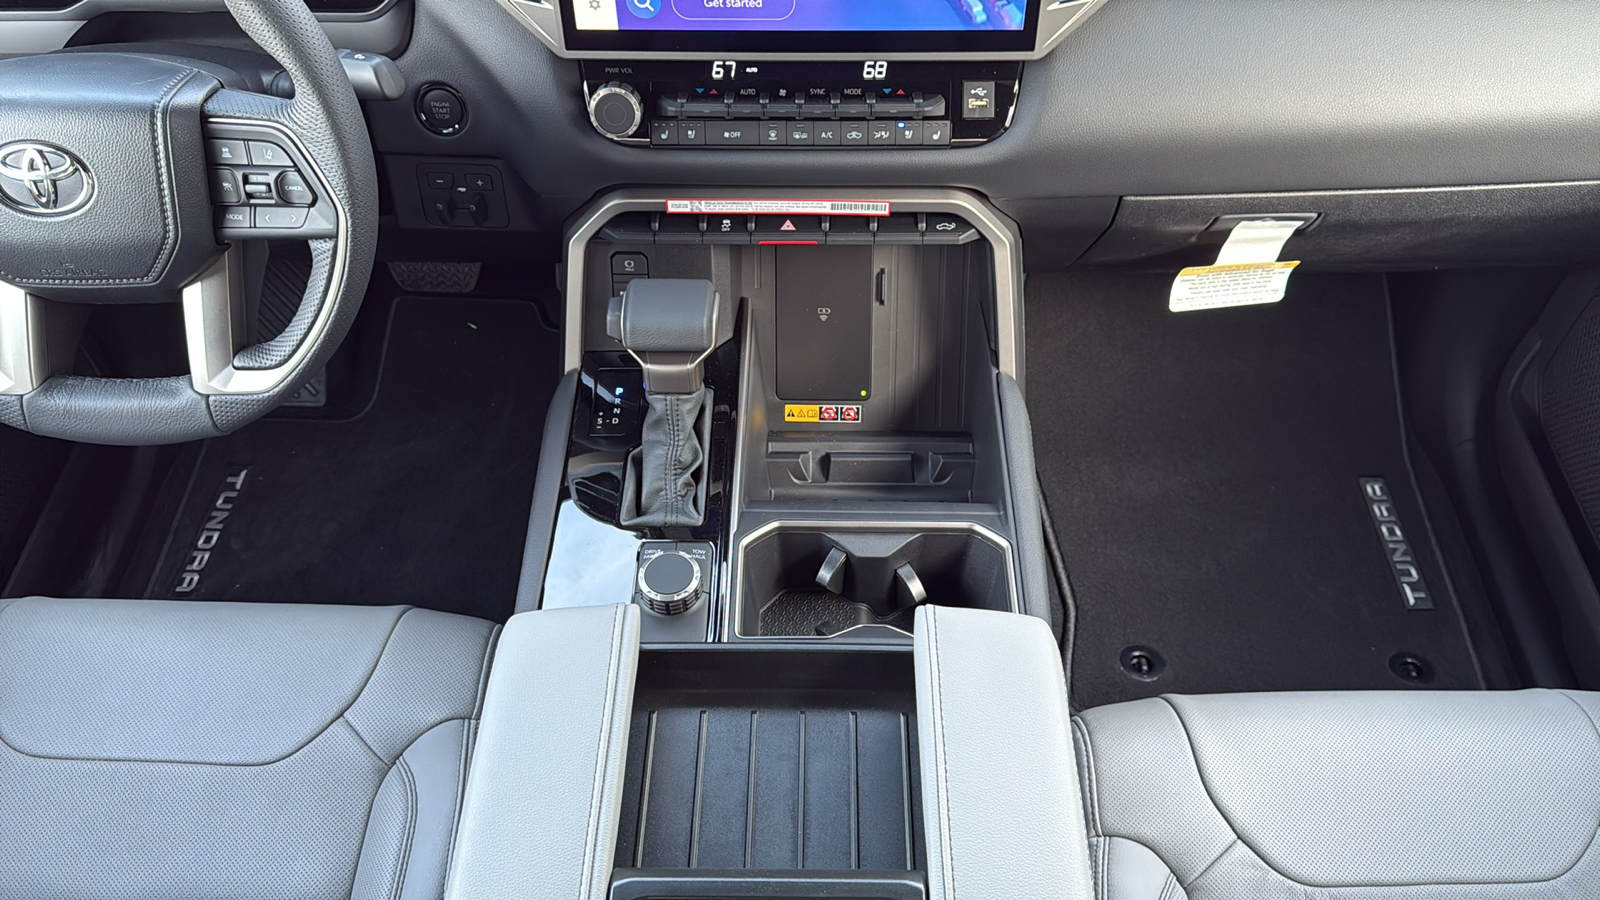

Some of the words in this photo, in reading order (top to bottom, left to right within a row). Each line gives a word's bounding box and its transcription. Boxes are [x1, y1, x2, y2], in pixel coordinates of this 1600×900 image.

[704, 0, 724, 8] Get
[726, 0, 763, 8] started
[711, 60, 737, 79] 67
[862, 60, 888, 79] 68
[740, 88, 756, 96] AUTO
[809, 88, 826, 96] SYNC
[844, 88, 862, 96] MODE
[729, 131, 742, 139] OFF
[821, 131, 834, 139] A/C
[226, 213, 244, 221] MODE
[615, 387, 624, 396] P
[596, 417, 603, 425] S
[175, 469, 248, 592] TUNDRA
[1365, 482, 1426, 607] TUNDRA
